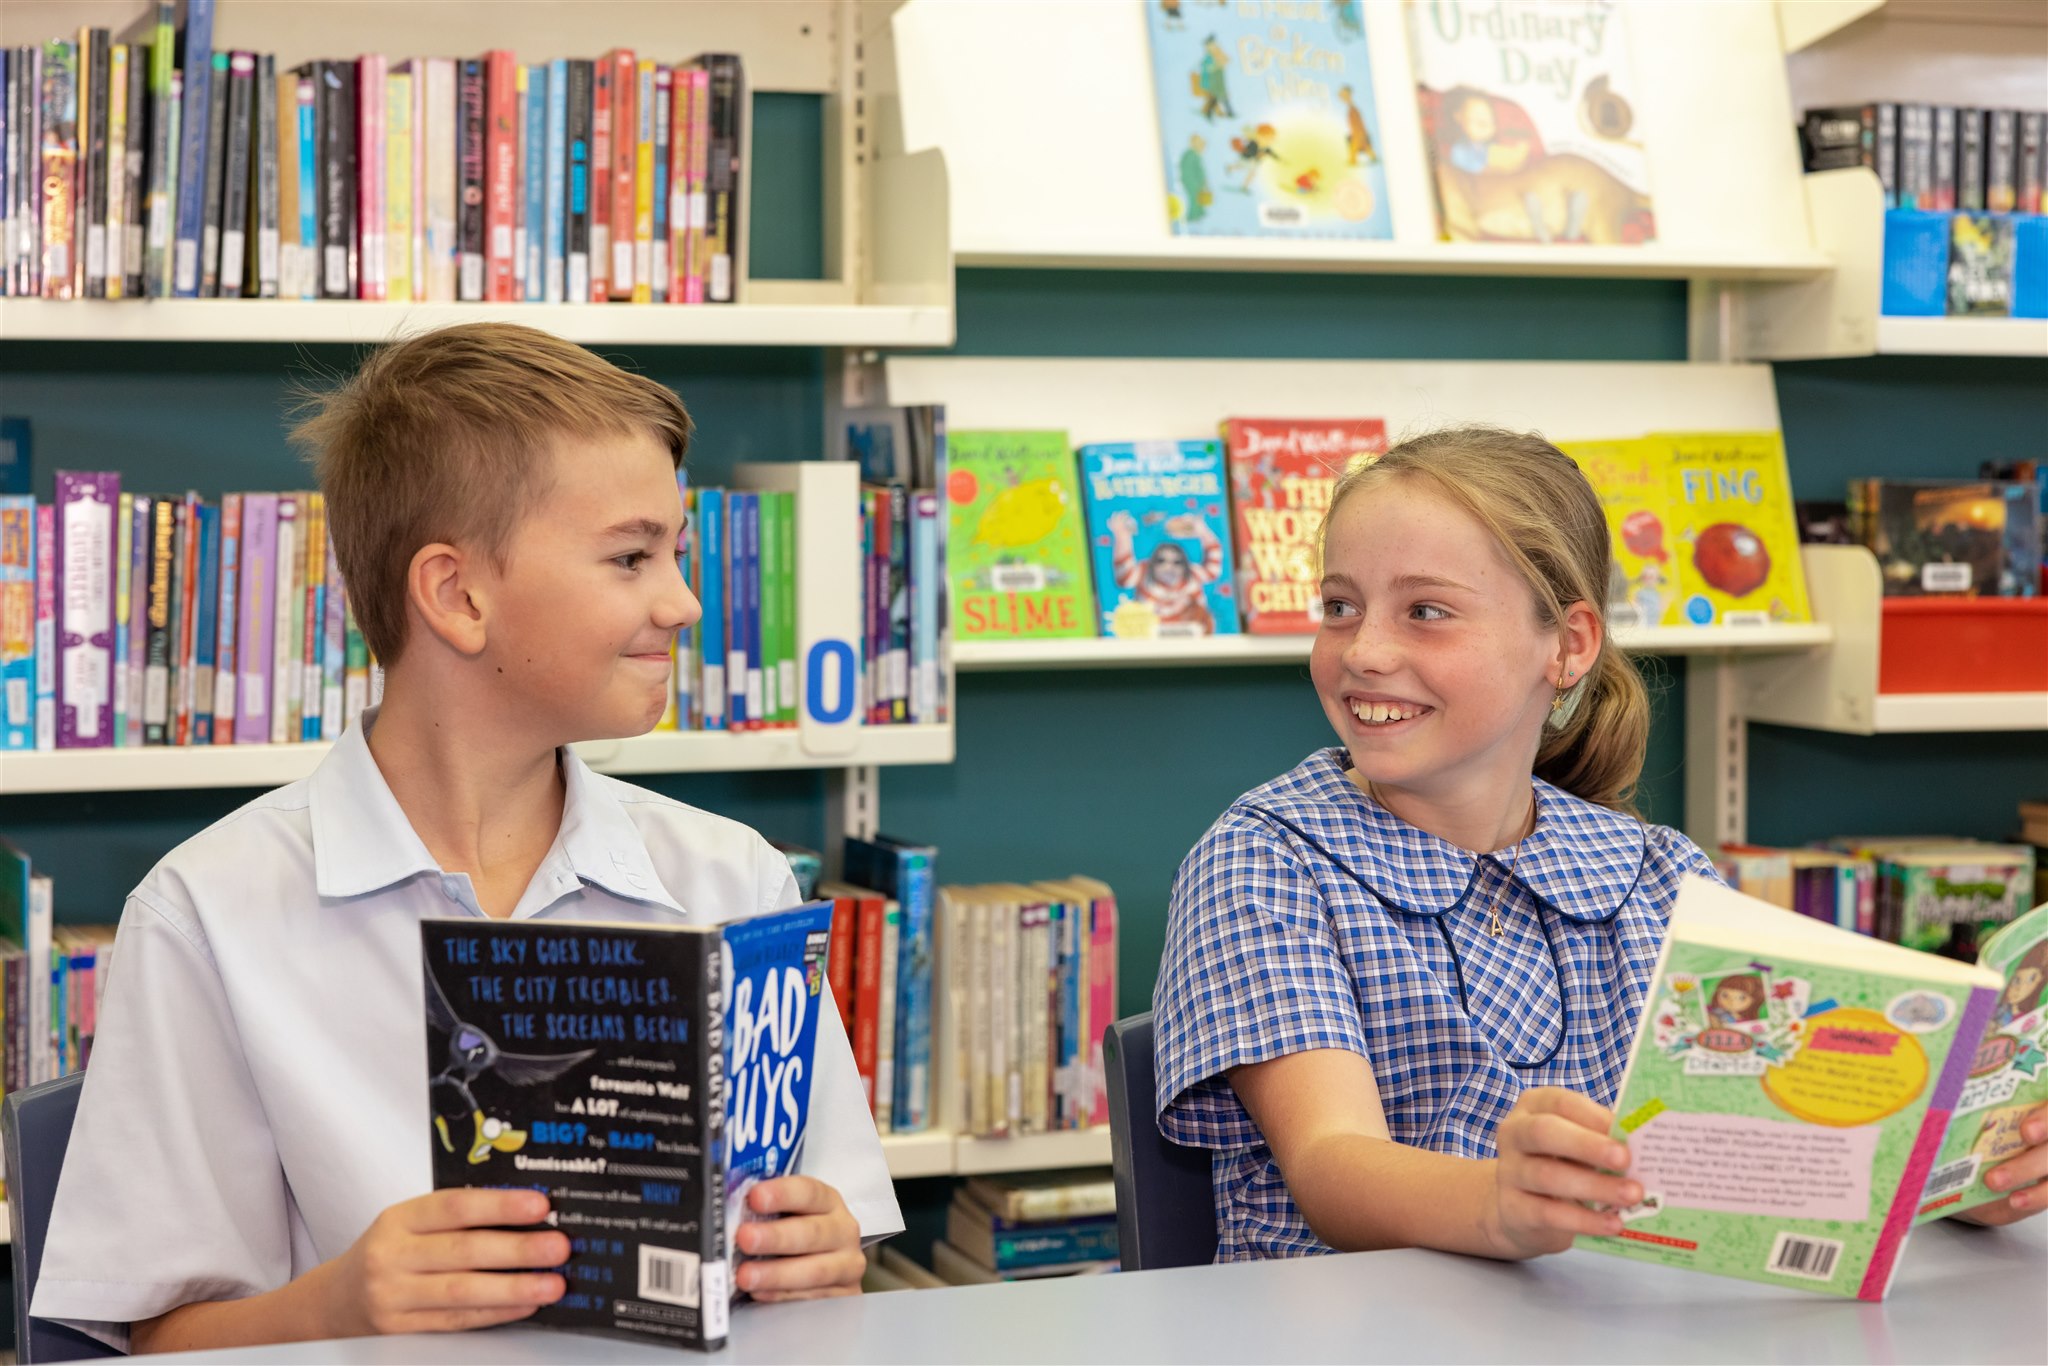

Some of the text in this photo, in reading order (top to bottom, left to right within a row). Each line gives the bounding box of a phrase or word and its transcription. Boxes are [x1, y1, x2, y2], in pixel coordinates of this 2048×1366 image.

[1430, 0, 1611, 57] Ordinary
[1236, 33, 1346, 76] Broken
[1500, 47, 1578, 101] Day
[1681, 469, 1764, 503] FING
[963, 588, 1078, 636] SLIME
[443, 937, 645, 966] THE SKY GOES DARK.
[469, 976, 678, 1007] THE CITY TREMBLES.
[501, 1013, 689, 1045] THE SCREAMS BEGIN
[706, 991, 723, 1048] BAD
[731, 966, 807, 1078] BAD
[571, 1096, 586, 1115] A
[586, 1097, 620, 1118] LOT
[656, 1080, 691, 1101] Wolf
[707, 1052, 725, 1130] GUYS
[531, 1119, 588, 1147] BIG?
[607, 1131, 656, 1151] BAD?
